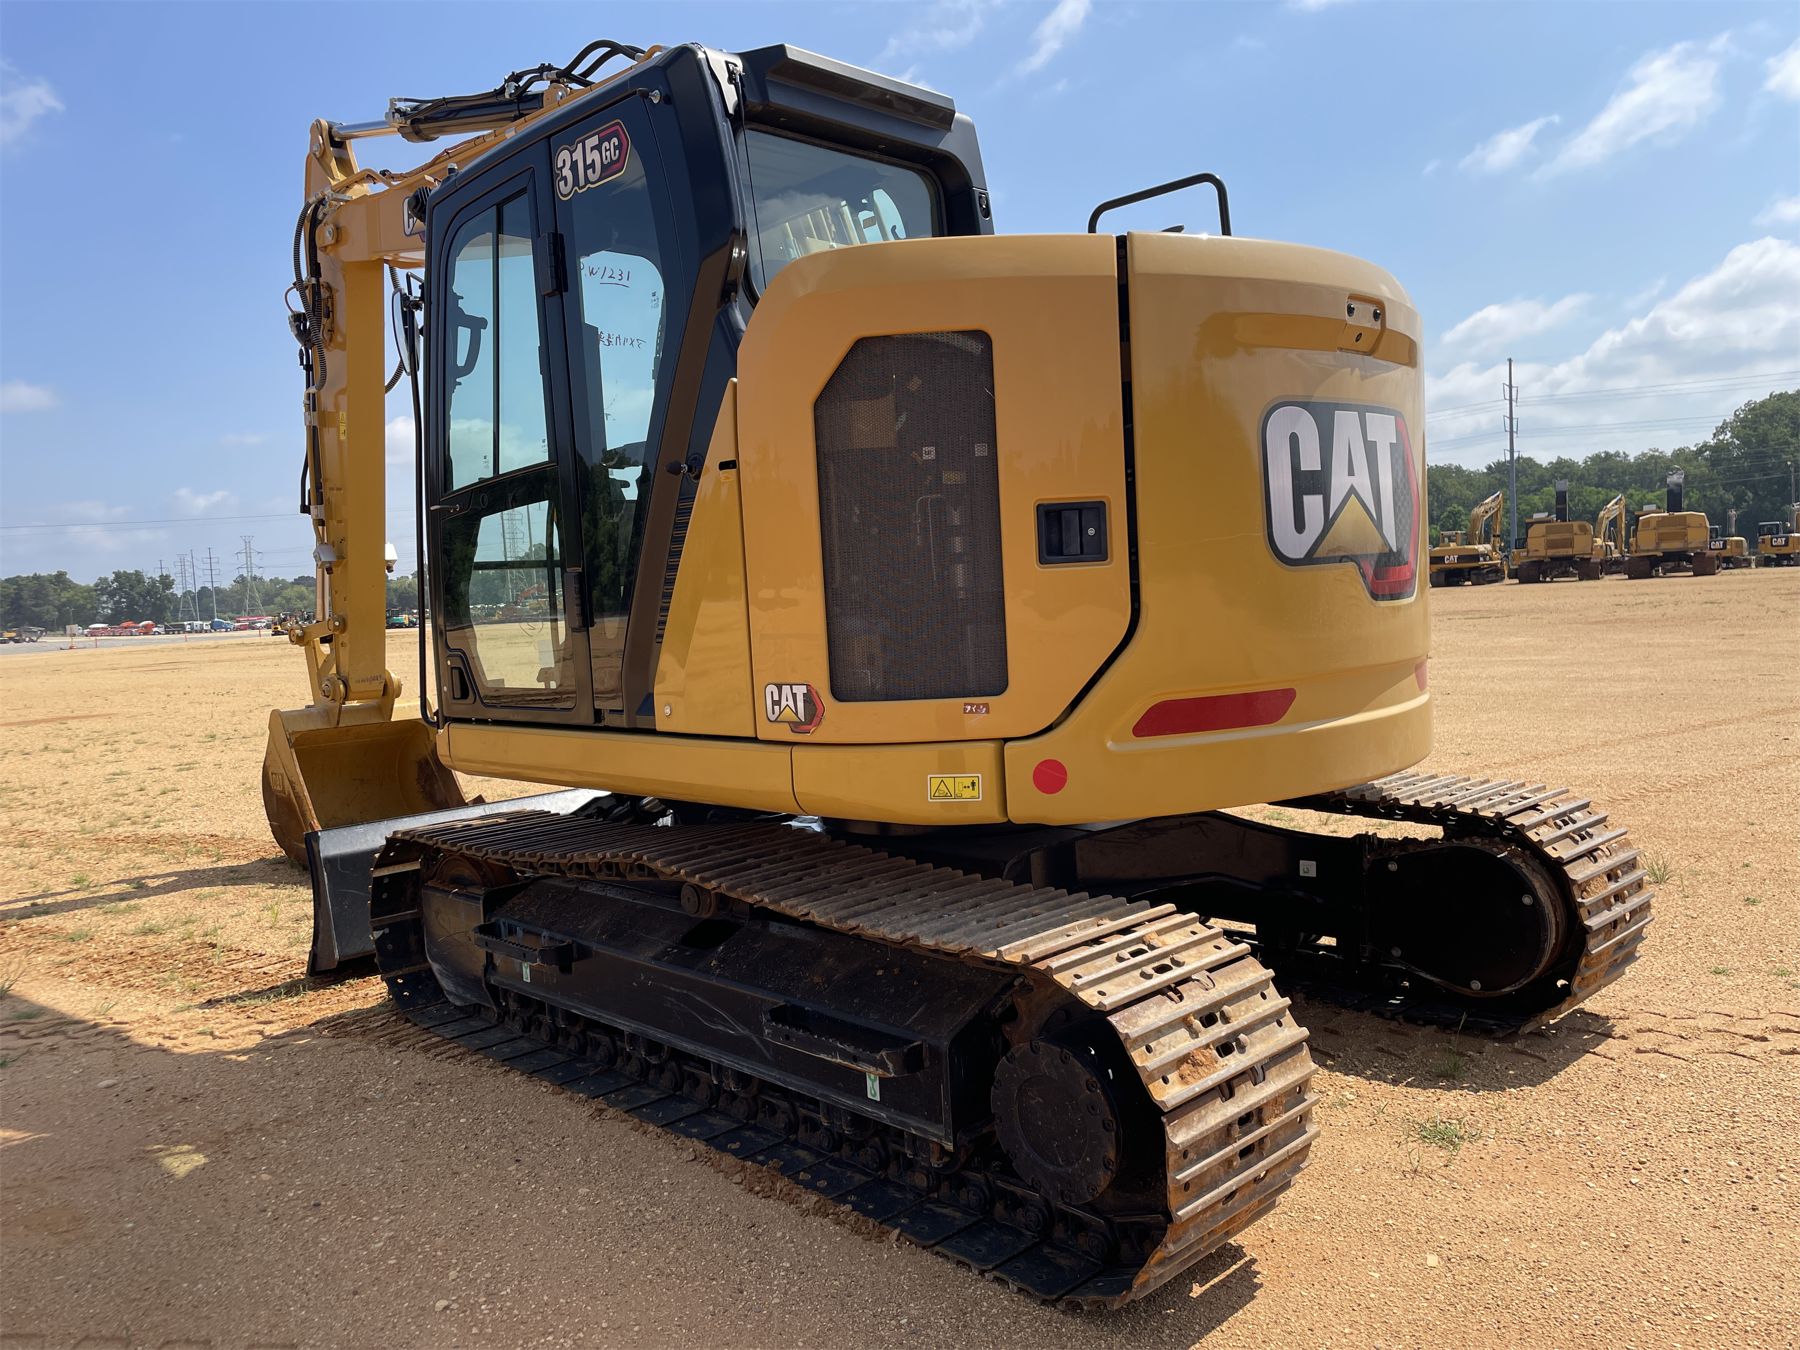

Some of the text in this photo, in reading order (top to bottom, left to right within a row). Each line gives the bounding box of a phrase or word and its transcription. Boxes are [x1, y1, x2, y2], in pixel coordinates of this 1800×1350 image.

[556, 134, 620, 195] 315 GC
[1265, 405, 1397, 559] CAT
[1710, 540, 1724, 549] CAT
[1772, 537, 1786, 546] CAT
[1444, 554, 1459, 564] CAT
[765, 684, 808, 722] CAT
